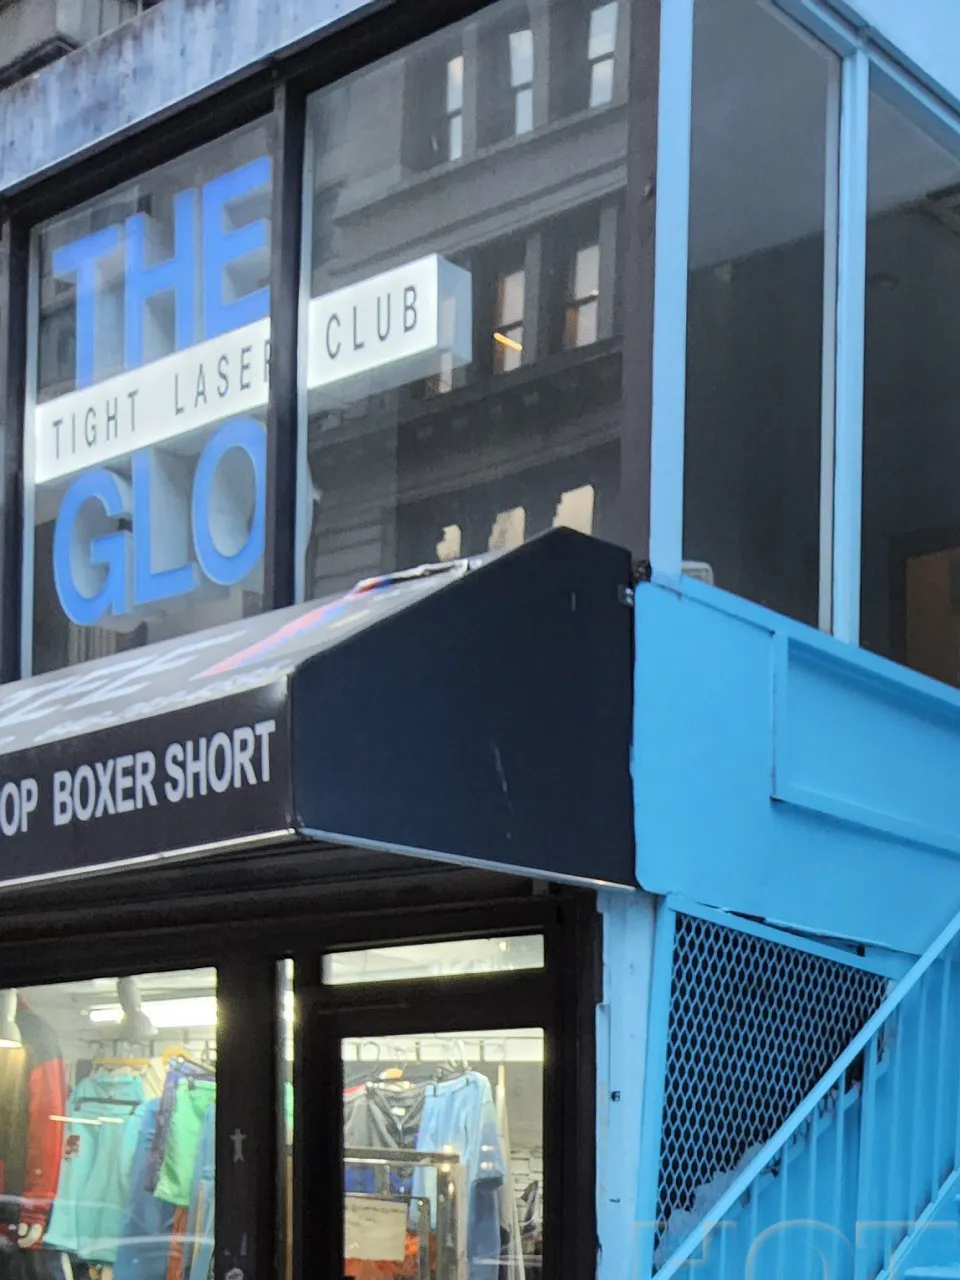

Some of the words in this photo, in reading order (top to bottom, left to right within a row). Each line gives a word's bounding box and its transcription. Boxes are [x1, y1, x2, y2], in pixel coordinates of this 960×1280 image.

[52, 155, 271, 391] THE
[52, 391, 141, 460] TIGHT
[326, 285, 419, 360] CLUB
[53, 418, 268, 626] GLO
[53, 750, 158, 827] BOXER
[164, 719, 277, 803] SHORT
